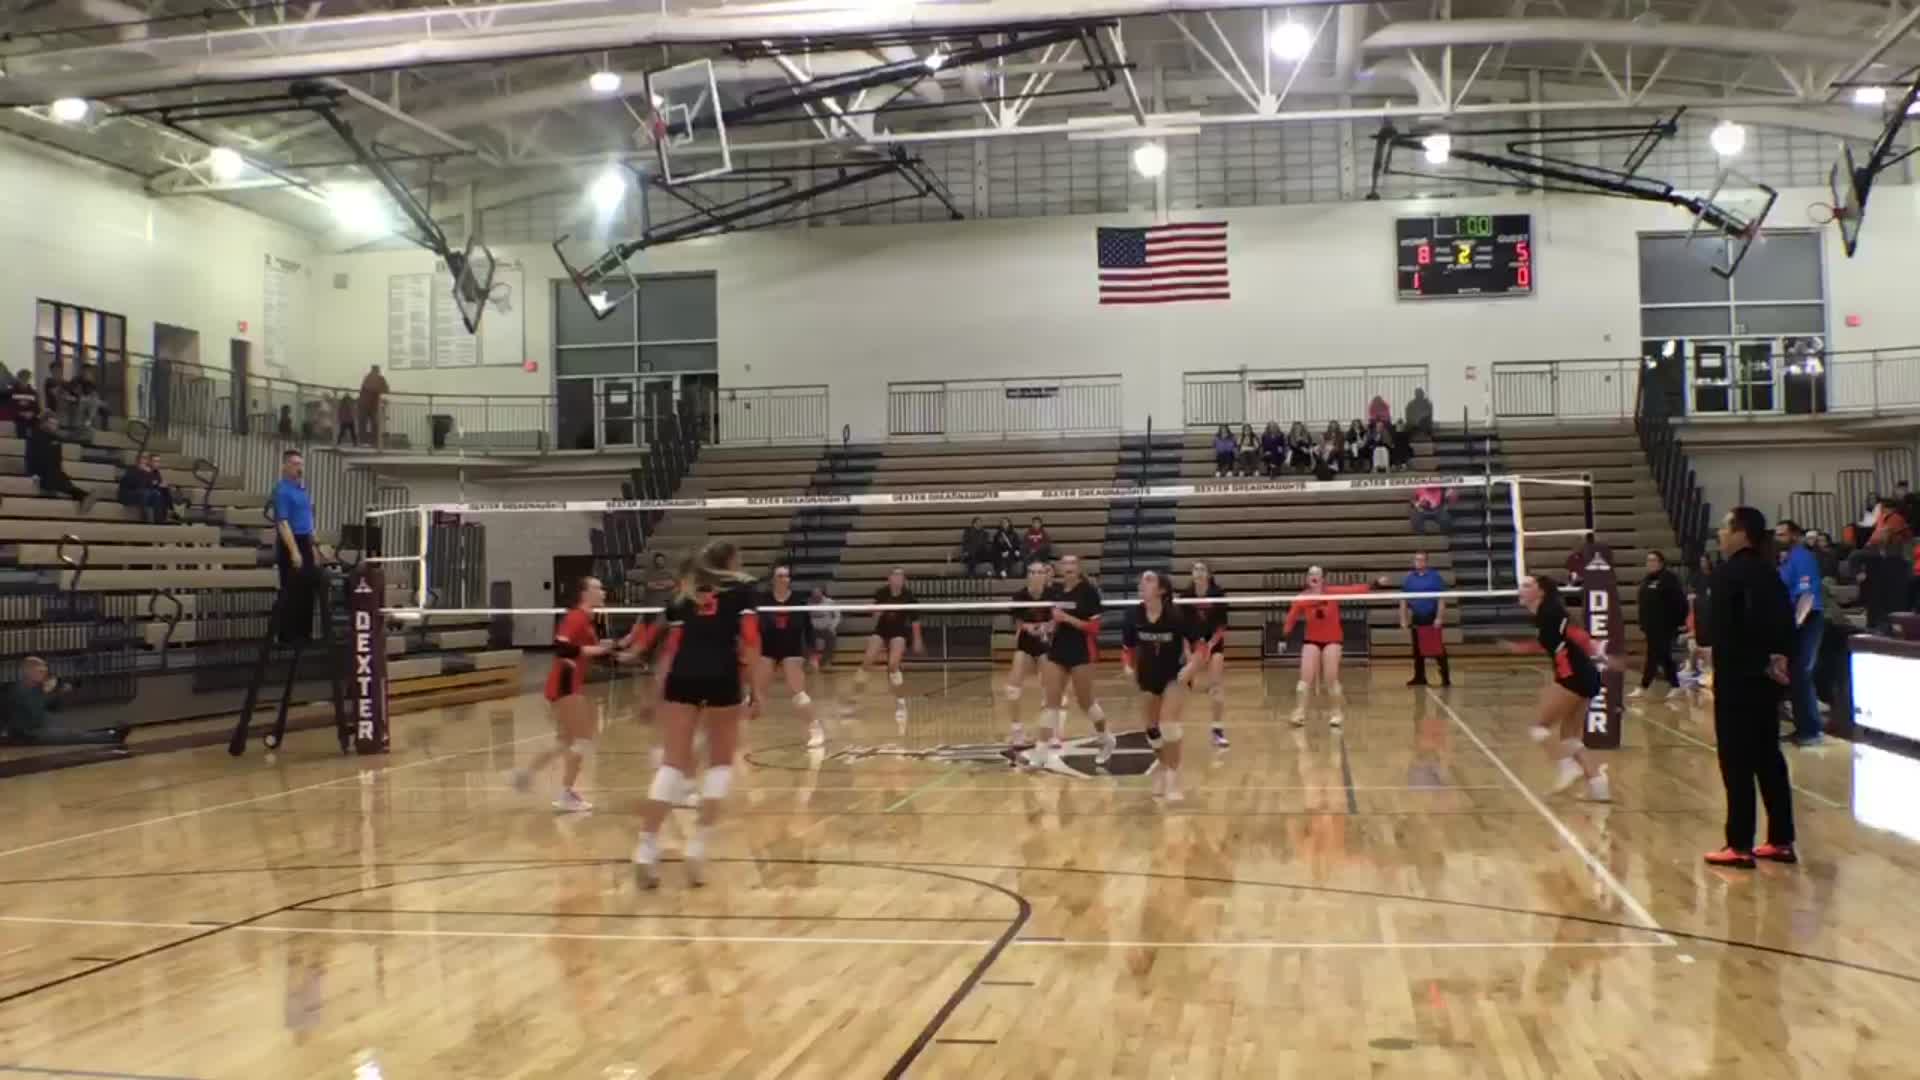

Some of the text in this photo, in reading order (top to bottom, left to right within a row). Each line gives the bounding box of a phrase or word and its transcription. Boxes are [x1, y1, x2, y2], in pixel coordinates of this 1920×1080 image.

[1417, 245, 1431, 265] 8
[1457, 244, 1472, 265] 2
[1515, 242, 1530, 262] 5
[1412, 271, 1421, 289] 1
[1517, 267, 1530, 285] 0
[1587, 590, 1609, 733] DEXER
[355, 610, 374, 741] DEXTER
